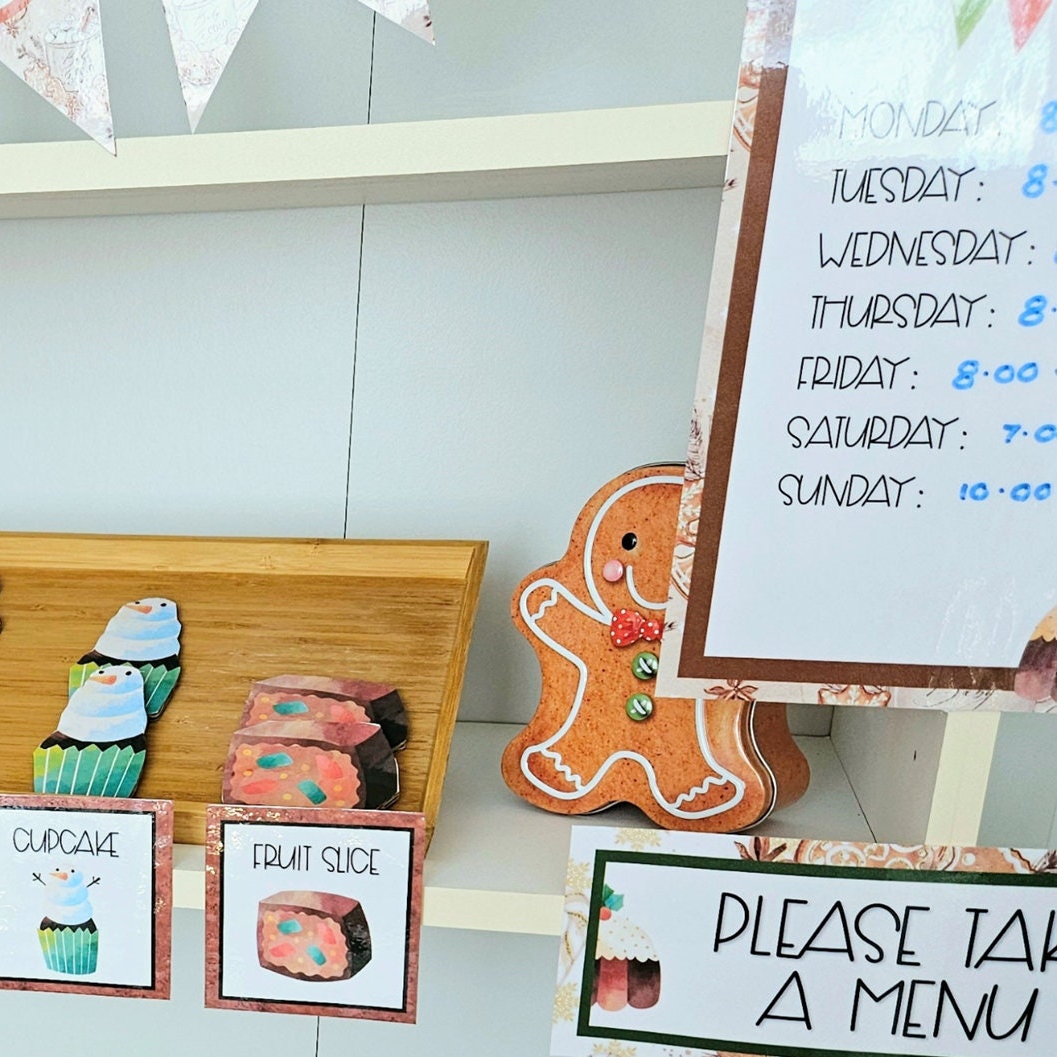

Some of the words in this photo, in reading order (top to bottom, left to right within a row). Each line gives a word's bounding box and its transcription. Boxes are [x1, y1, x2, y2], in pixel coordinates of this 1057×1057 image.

[831, 166, 984, 204] TUESDAY:
[820, 229, 1035, 268] WEDNESDAY:
[811, 293, 995, 329] THURSDAY:
[797, 355, 918, 390] FRIDAY:
[786, 415, 968, 450] SATURDAY:
[777, 473, 924, 508] SUNDAY:
[12, 827, 119, 858] CUPCAKE
[252, 843, 312, 872] FRUIT
[321, 847, 380, 876] SLICE
[713, 892, 930, 966] PLEASE
[965, 907, 1057, 973] TAK
[756, 970, 812, 1030] A
[851, 978, 1039, 1042] MENU
